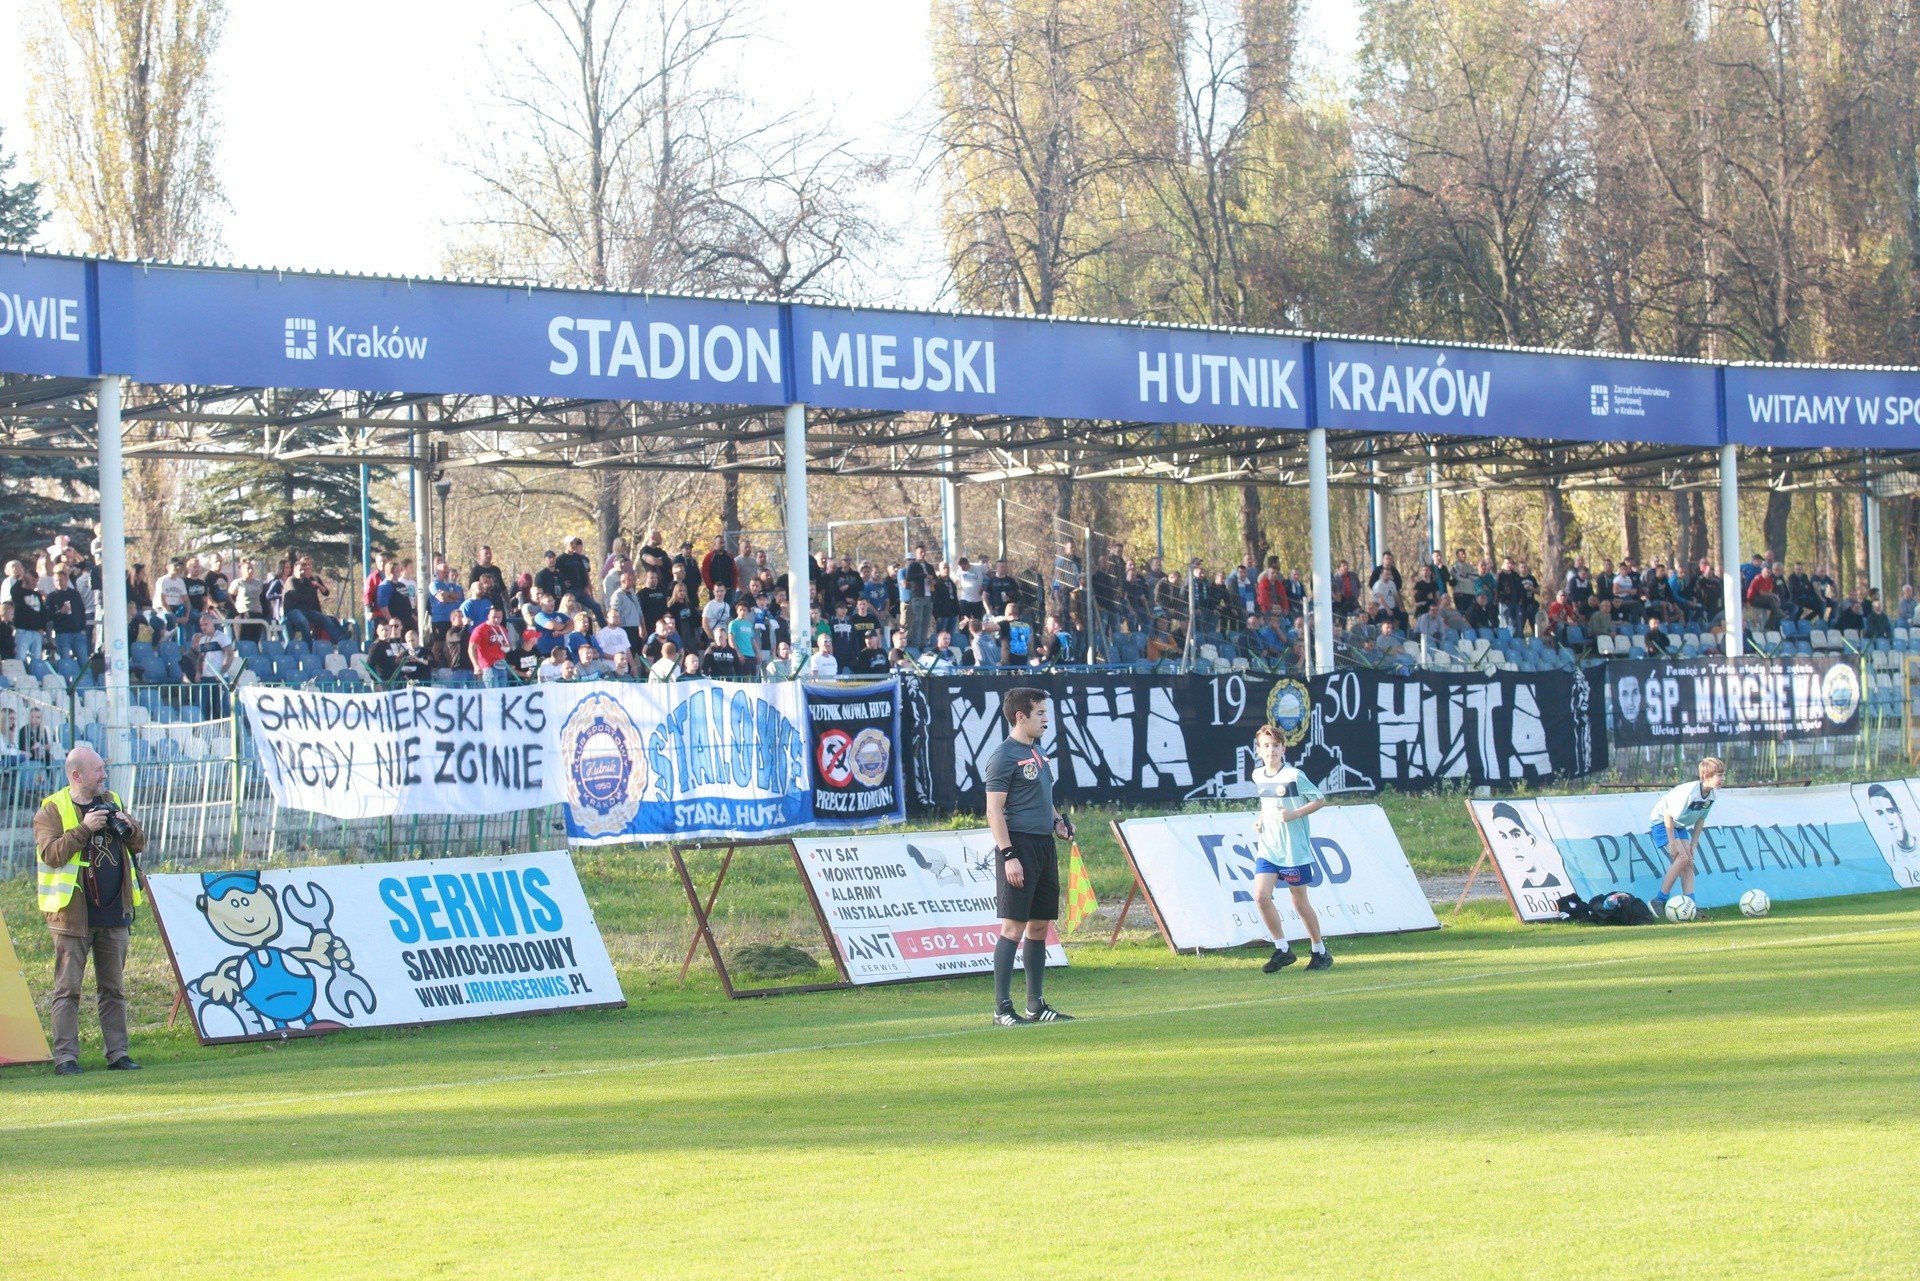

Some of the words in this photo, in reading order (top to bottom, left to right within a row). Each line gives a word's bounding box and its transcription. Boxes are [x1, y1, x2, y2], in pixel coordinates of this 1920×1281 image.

[327, 324, 429, 360] Kraków
[547, 315, 782, 384] STADION
[812, 330, 996, 394] MIEJSKI
[1139, 351, 1299, 410] HUTNIK
[1328, 353, 1490, 419] KRAKÓW
[1614, 384, 1633, 396] Zarząd
[1614, 396, 1641, 406] Sportowej
[1747, 394, 1850, 425] WITAMY
[1855, 397, 1880, 425] W
[1665, 664, 1698, 677] Pamięć
[1708, 663, 1735, 675] Tobie
[1644, 669, 1689, 725] ŚP.
[1694, 673, 1825, 724] MARCHEWA
[256, 691, 484, 733] SANDOMIERSKI
[501, 690, 547, 733] KS
[842, 702, 869, 720] NOWA
[868, 701, 892, 719] HUTA
[1209, 674, 1247, 726] 19
[1324, 671, 1361, 724] 50
[1376, 680, 1552, 780] HUTA
[574, 737, 587, 773] KLUB
[587, 725, 628, 766] SPORTOWY
[267, 738, 354, 791] NIGDY
[374, 736, 422, 790] NIE
[434, 741, 544, 790] ZGINIE
[585, 760, 617, 777] Hutnik
[595, 781, 612, 791] 1950
[815, 788, 848, 812] PRECZ
[848, 793, 856, 812] Z
[674, 802, 735, 828] STARA
[736, 801, 788, 825] HUTA
[815, 848, 833, 862] TV
[835, 847, 860, 862] SAT
[821, 864, 907, 882] MONITORING
[379, 867, 564, 945] SERWIS
[831, 886, 882, 902] ALARMY
[838, 902, 918, 921] INSTALACJE
[848, 933, 896, 960] ANT
[921, 932, 960, 952] 502
[962, 930, 999, 949] 170
[401, 936, 580, 982] SAMOCHODOWY
[860, 962, 899, 972] SERWIS
[414, 973, 593, 1008] WWW.IRMARSERWIS.PL
